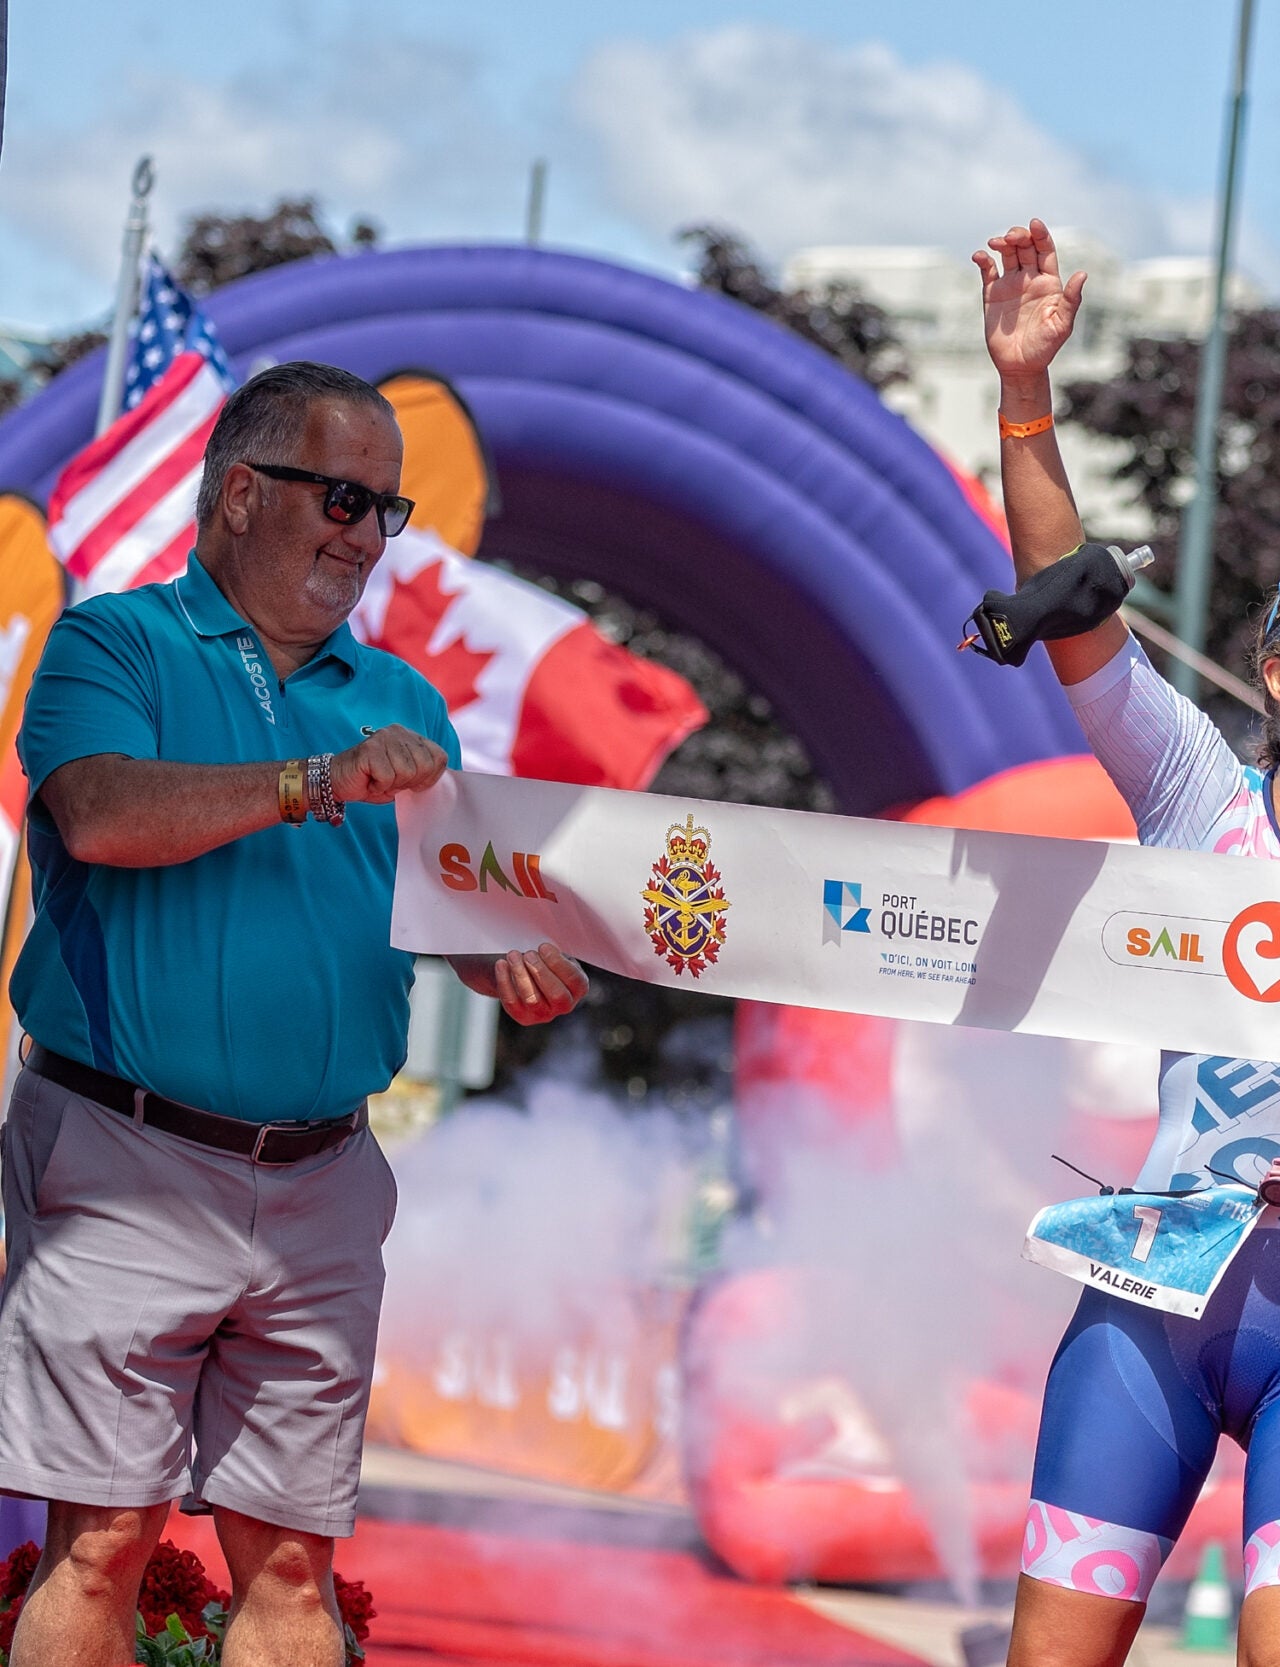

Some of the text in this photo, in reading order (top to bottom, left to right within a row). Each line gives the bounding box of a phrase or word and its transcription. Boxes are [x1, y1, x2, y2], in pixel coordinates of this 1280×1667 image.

[237, 637, 275, 726] LACOSTE
[438, 839, 559, 904] SAIL
[882, 894, 917, 909] PORT
[881, 910, 979, 945] QUÉBEC
[1126, 926, 1204, 963] SAIL
[879, 967, 896, 975] FROM
[897, 970, 915, 978] HERE,
[916, 971, 927, 979] WE
[941, 974, 954, 982] FAR
[955, 976, 977, 985] AHEAD
[915, 957, 928, 967] ON
[931, 959, 952, 970] VOIT
[955, 962, 977, 972] LOIN
[1130, 1205, 1163, 1264] 1
[1090, 1263, 1157, 1299] VALERIE
